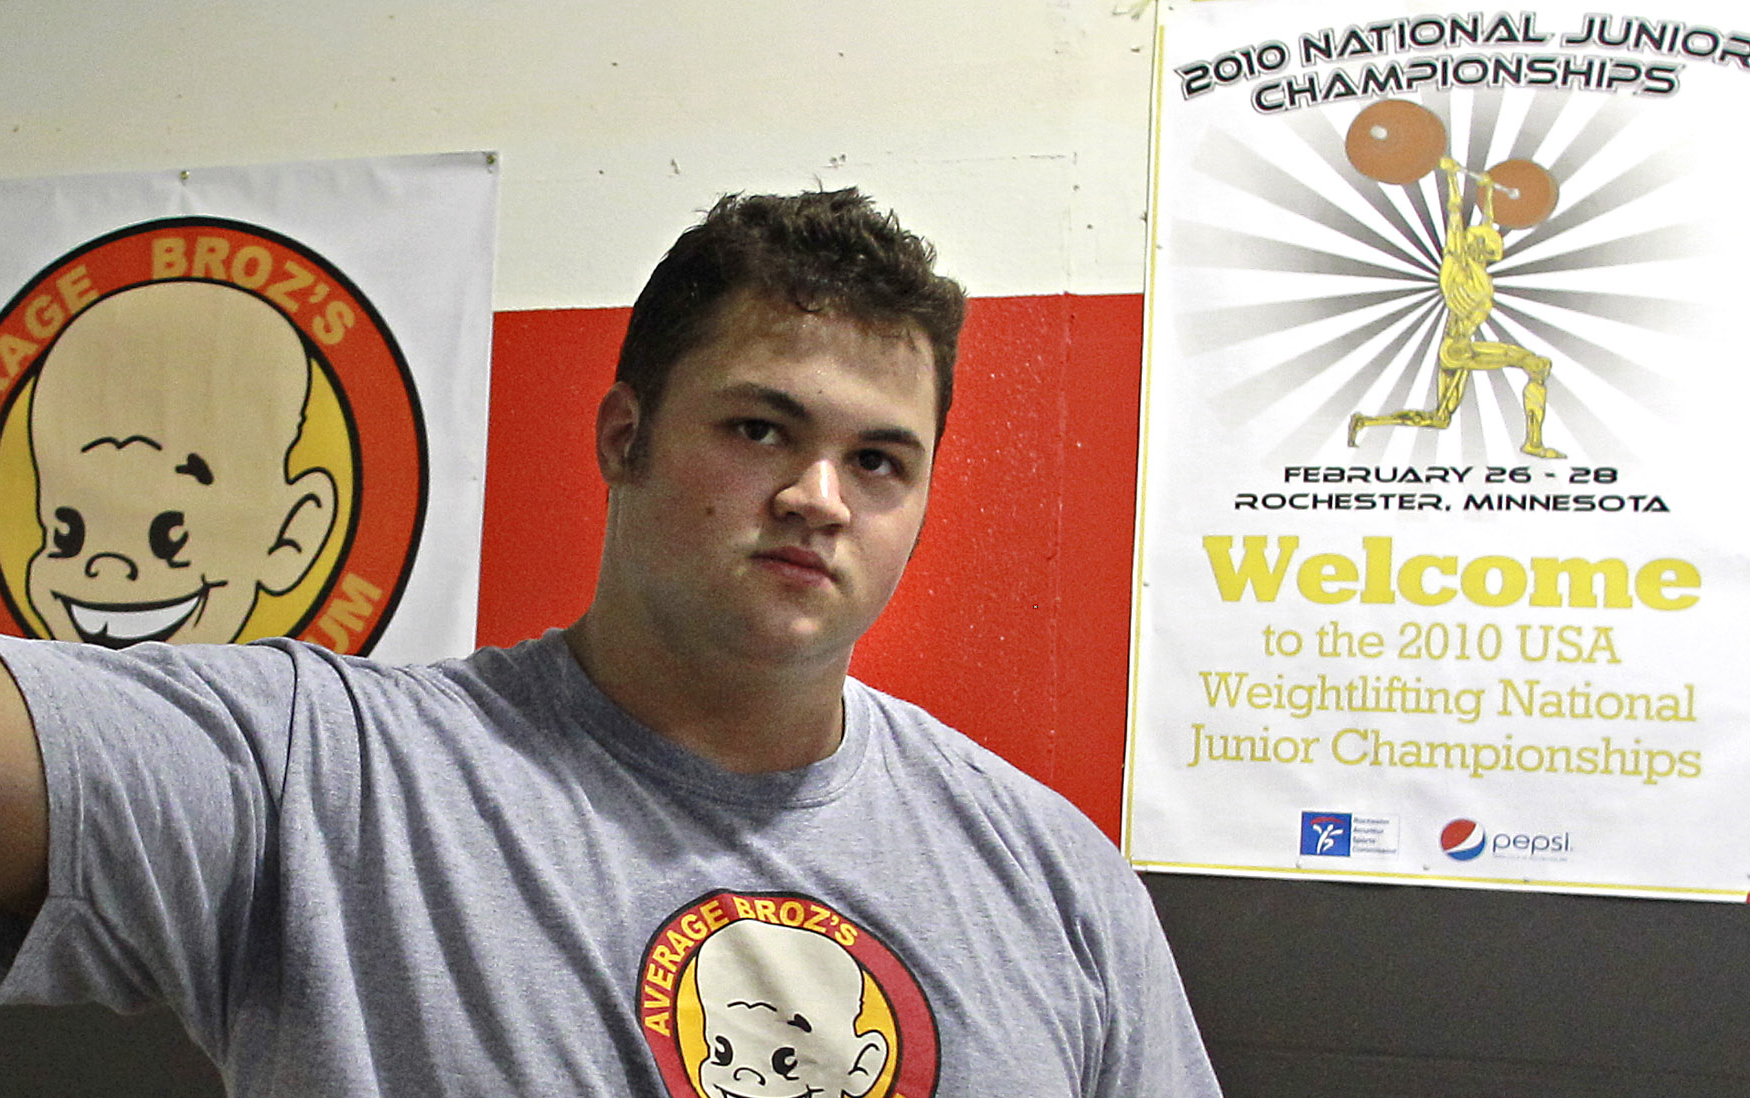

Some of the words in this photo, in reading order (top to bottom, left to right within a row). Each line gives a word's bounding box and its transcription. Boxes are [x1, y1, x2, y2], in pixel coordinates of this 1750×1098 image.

[1182, 42, 1288, 99] 2010
[1300, 13, 1552, 65] NATIONAL
[1564, 13, 1750, 70] JUNIOR
[1253, 54, 1684, 112] CHAMPIONSHIPS
[153, 236, 356, 346] BROZ'S
[1233, 492, 1452, 513] ROCHESTER,
[1463, 494, 1671, 512] MINNESOTA
[1284, 466, 1473, 484] FEBRUARY
[1484, 466, 1532, 484] 26
[1568, 466, 1619, 485] 28
[1202, 535, 1703, 612] Welcome
[1263, 624, 1303, 658] to
[1317, 622, 1385, 659] the
[1398, 622, 1503, 661] 2010
[1518, 625, 1622, 665] USA
[1199, 671, 1485, 724] Weightlifting
[1499, 679, 1697, 722] National
[1187, 723, 1320, 768] Junior
[1330, 728, 1703, 785] Championships
[1492, 831, 1570, 855] pepsi
[644, 899, 729, 1038] AVERAGE
[733, 896, 859, 946] BROZ'S
